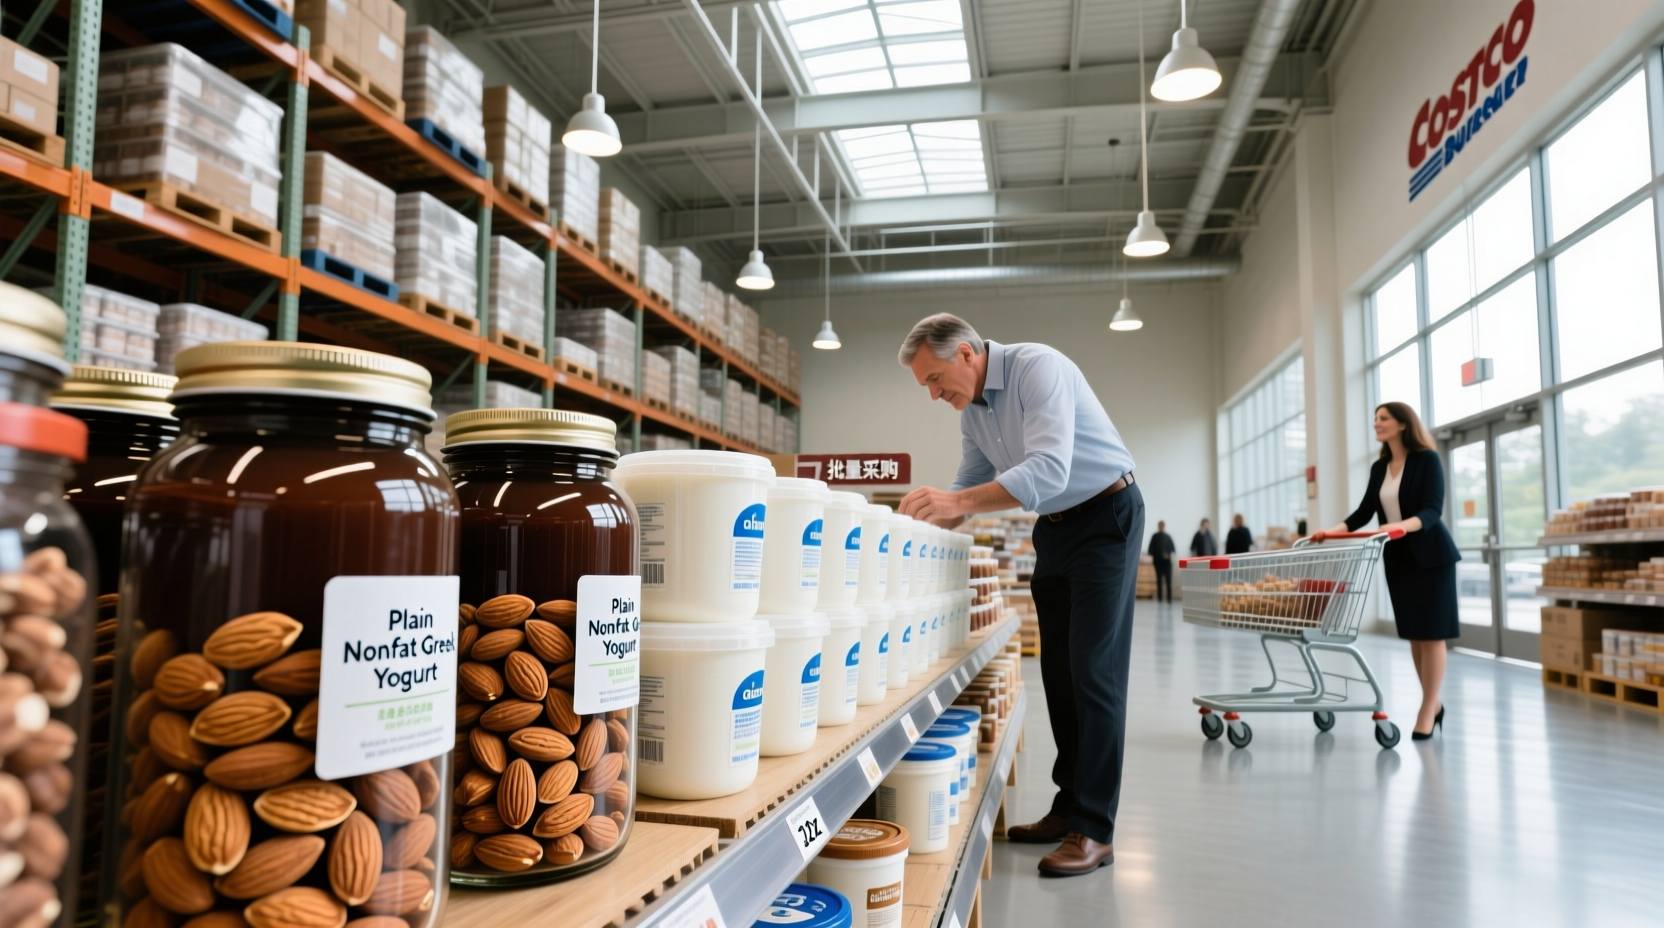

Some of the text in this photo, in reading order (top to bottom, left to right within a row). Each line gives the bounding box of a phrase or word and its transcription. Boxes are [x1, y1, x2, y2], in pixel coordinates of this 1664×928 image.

[1408, 0, 1535, 169] COSTCO
[827, 458, 899, 480] 批量采购
[611, 597, 635, 614] Plain
[389, 607, 434, 631] Plain
[343, 636, 417, 663] Nonfat
[602, 639, 637, 659] Yogurt
[373, 662, 438, 693] Yogurt
